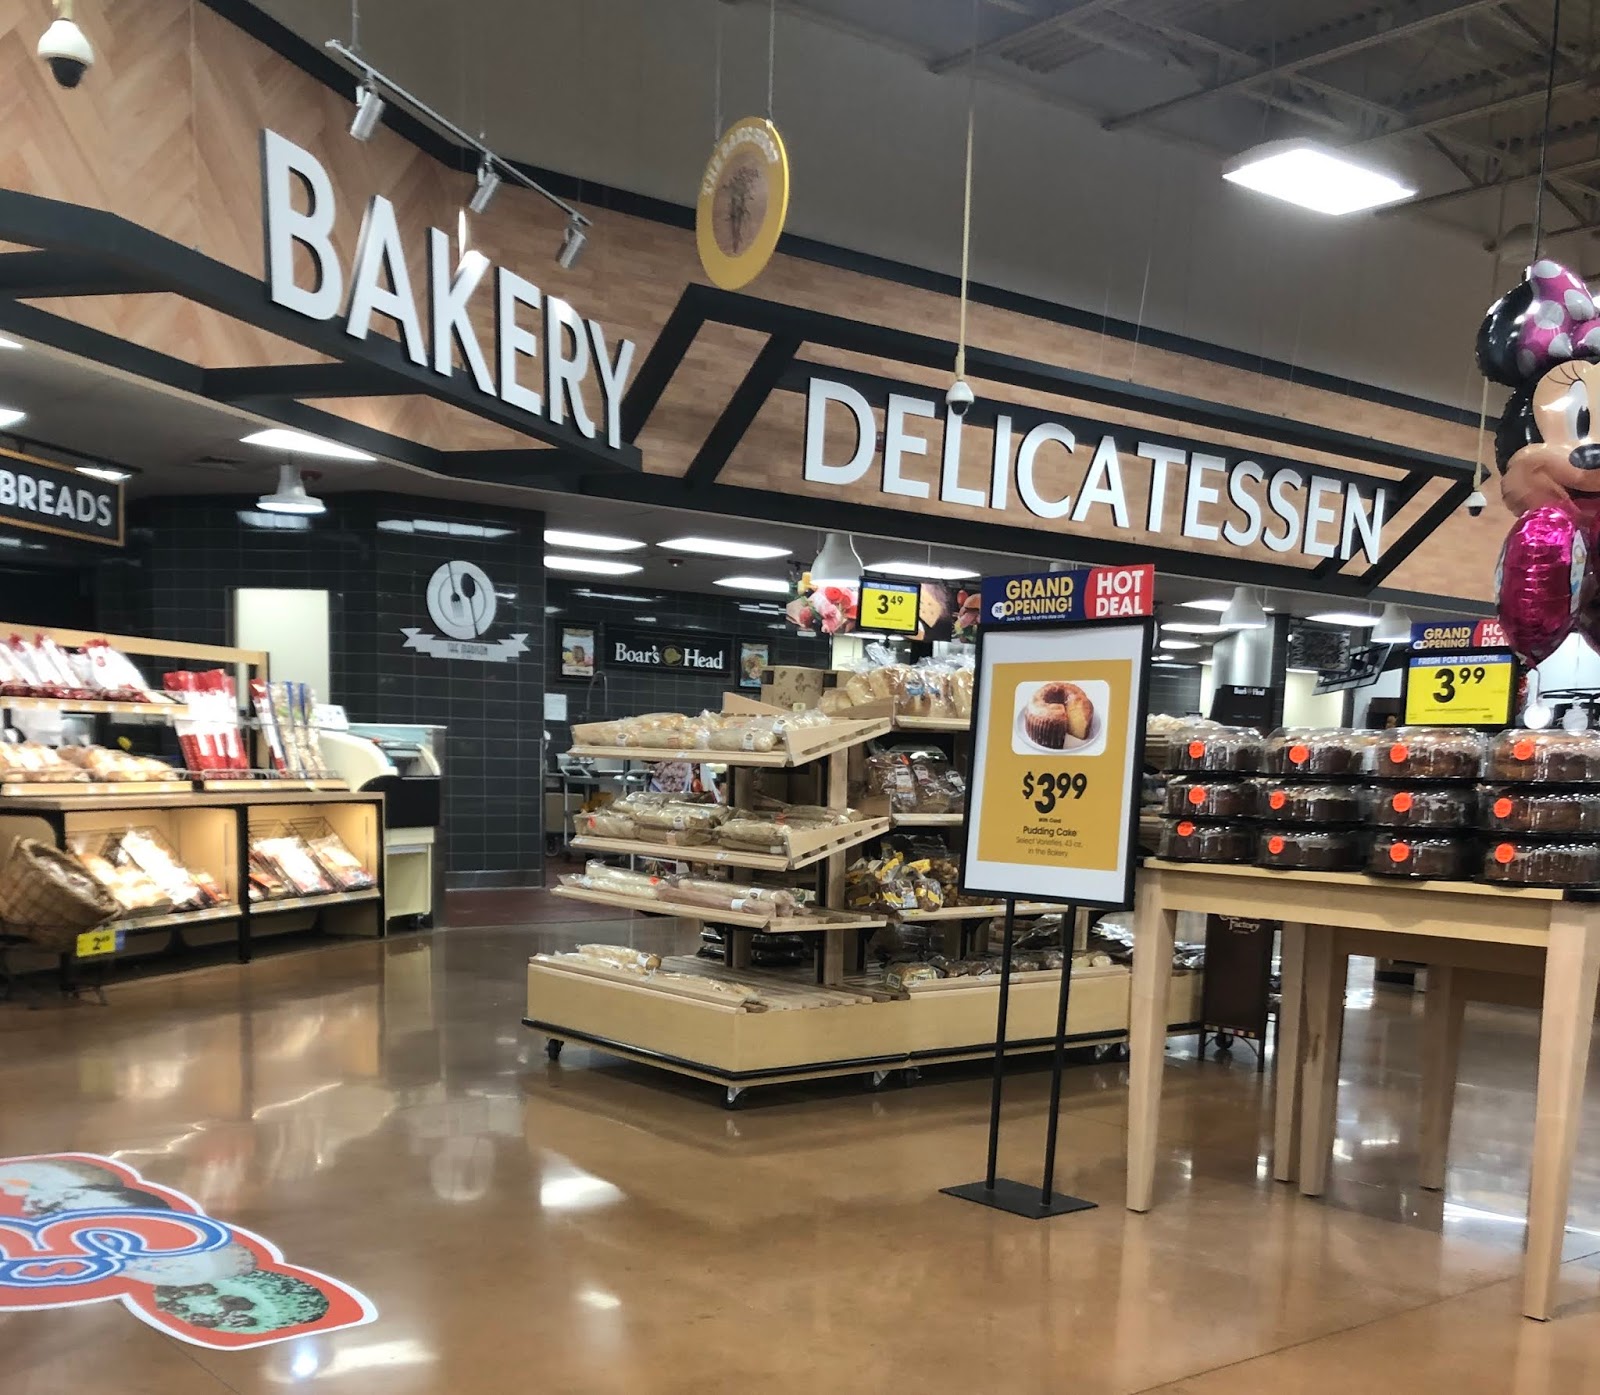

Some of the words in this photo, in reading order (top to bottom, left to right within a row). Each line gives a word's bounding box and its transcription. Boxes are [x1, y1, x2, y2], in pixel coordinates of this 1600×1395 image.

[261, 128, 636, 450] BAKERY
[804, 377, 1385, 565] DELICATESSEN
[0, 469, 112, 527] BREADS
[1005, 576, 1074, 600] GRAND
[1096, 570, 1145, 595] HOT
[1002, 597, 1073, 616] OPENING!
[1095, 595, 1144, 617] DEAL
[1423, 627, 1471, 640] GRAND
[1482, 624, 1505, 636] HO
[1422, 638, 1470, 649] OPENING!
[1481, 636, 1510, 647] DEA
[614, 642, 660, 664] Boar's
[683, 648, 723, 669] Head
[1023, 825, 1055, 838] Pudding
[1056, 827, 1077, 837] Cake
[1047, 849, 1068, 858] Bakery
